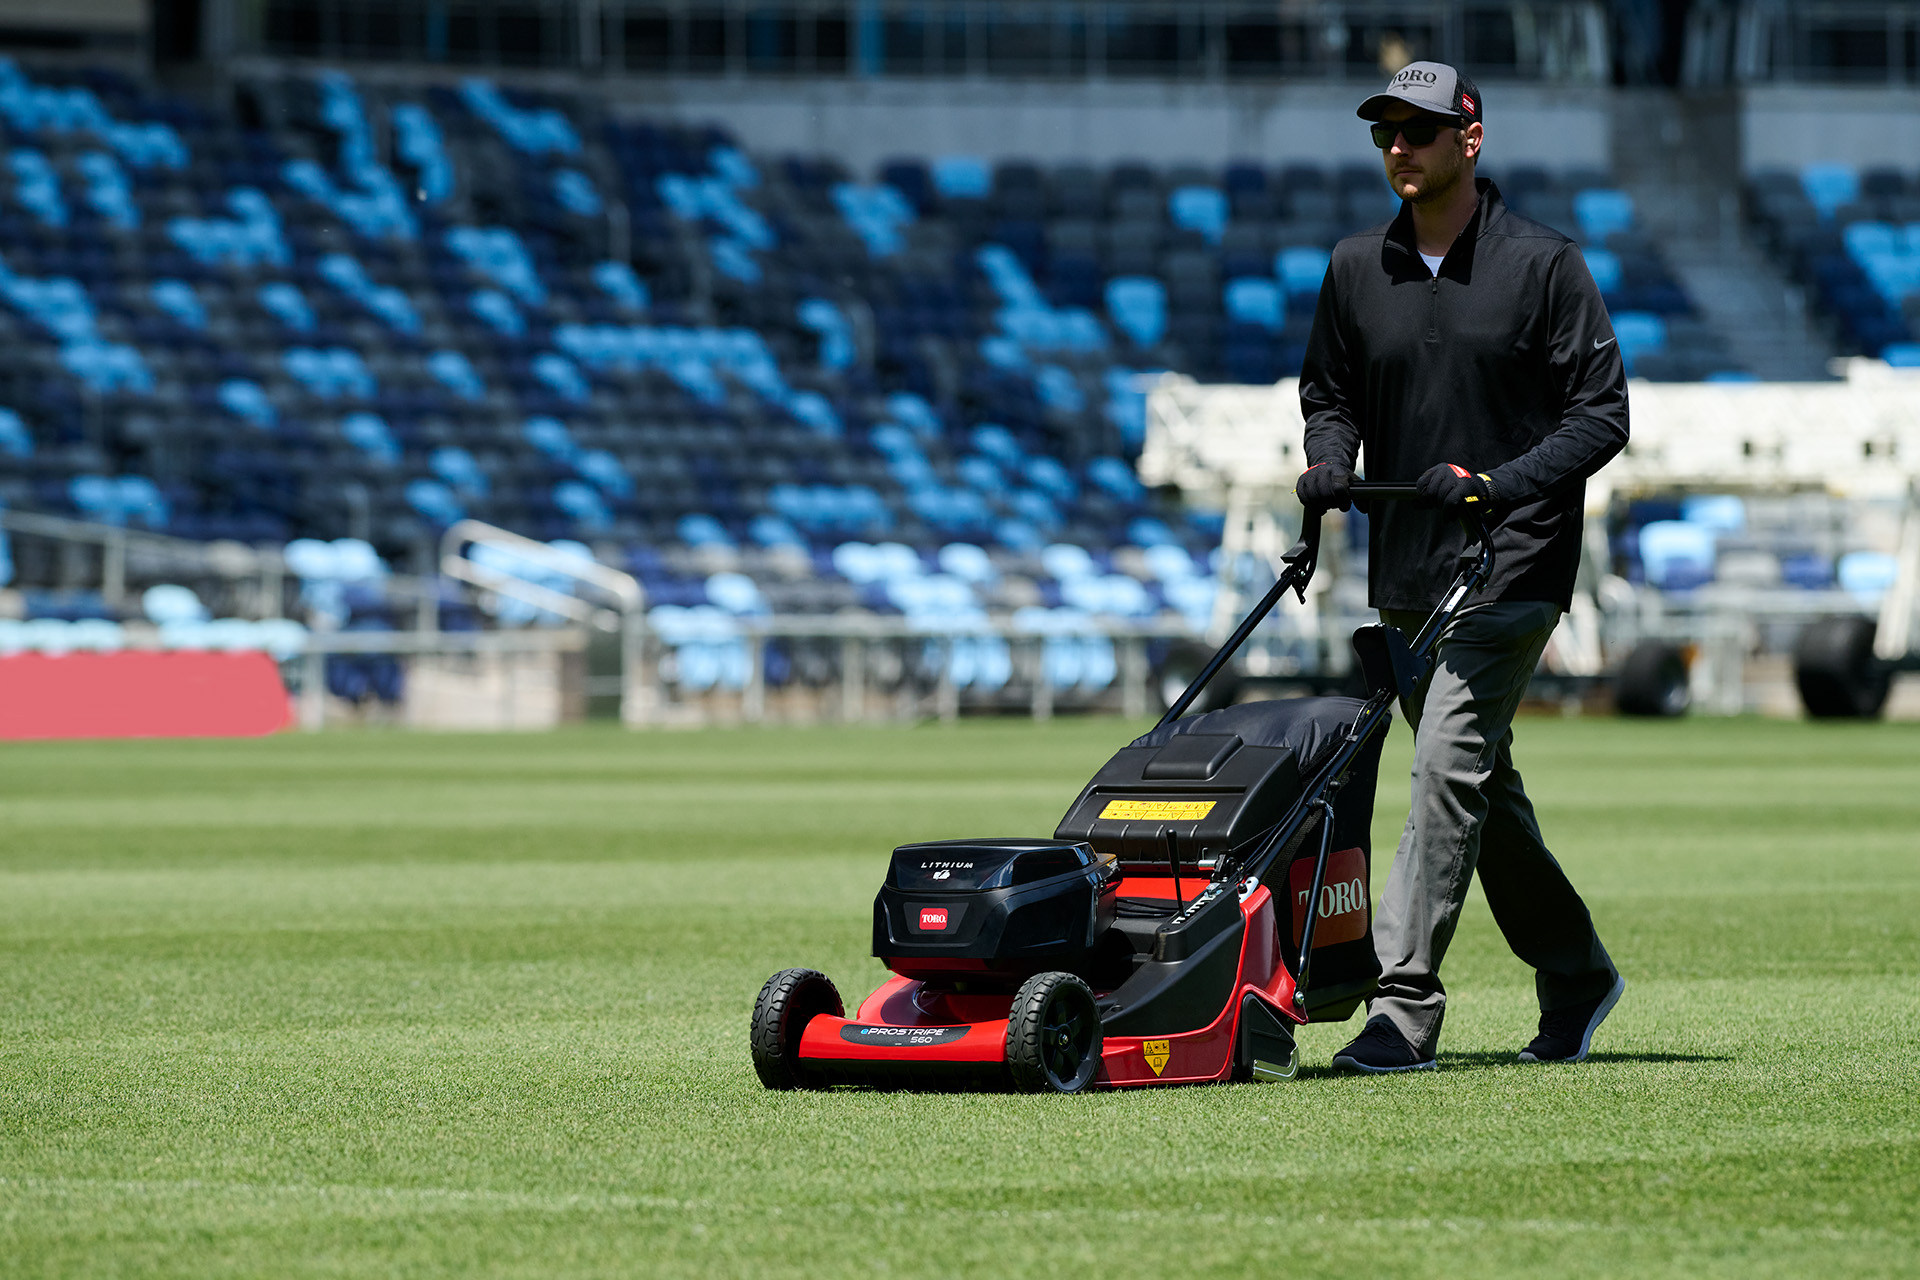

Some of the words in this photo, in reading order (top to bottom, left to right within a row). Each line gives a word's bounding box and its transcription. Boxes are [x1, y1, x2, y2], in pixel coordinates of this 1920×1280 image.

[920, 861, 974, 869] LITHIUM
[921, 914, 946, 923] TORO
[860, 1027, 946, 1036] ePROSTRIPE
[909, 1036, 933, 1044] 560
